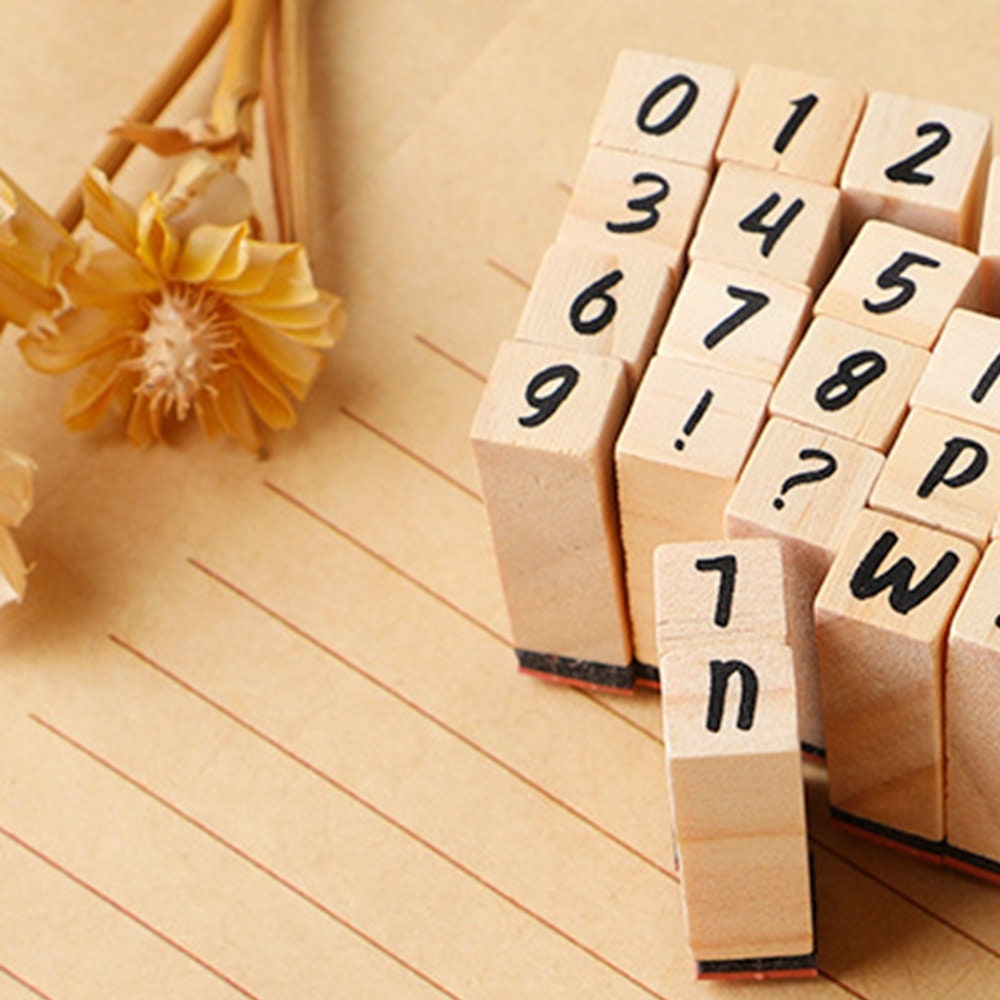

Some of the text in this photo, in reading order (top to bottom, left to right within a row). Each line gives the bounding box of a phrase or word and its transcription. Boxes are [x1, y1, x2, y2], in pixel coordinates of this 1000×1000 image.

[774, 95, 818, 153] 1
[886, 123, 950, 186] 2
[607, 173, 669, 234] 3
[739, 193, 804, 257] 4
[570, 270, 624, 334] 6
[864, 252, 940, 314] 5
[704, 286, 770, 350] 7
[518, 364, 579, 427] 9
[816, 351, 887, 412] 8
[774, 449, 837, 510] ?
[917, 437, 988, 498] P
[850, 531, 959, 615] W
